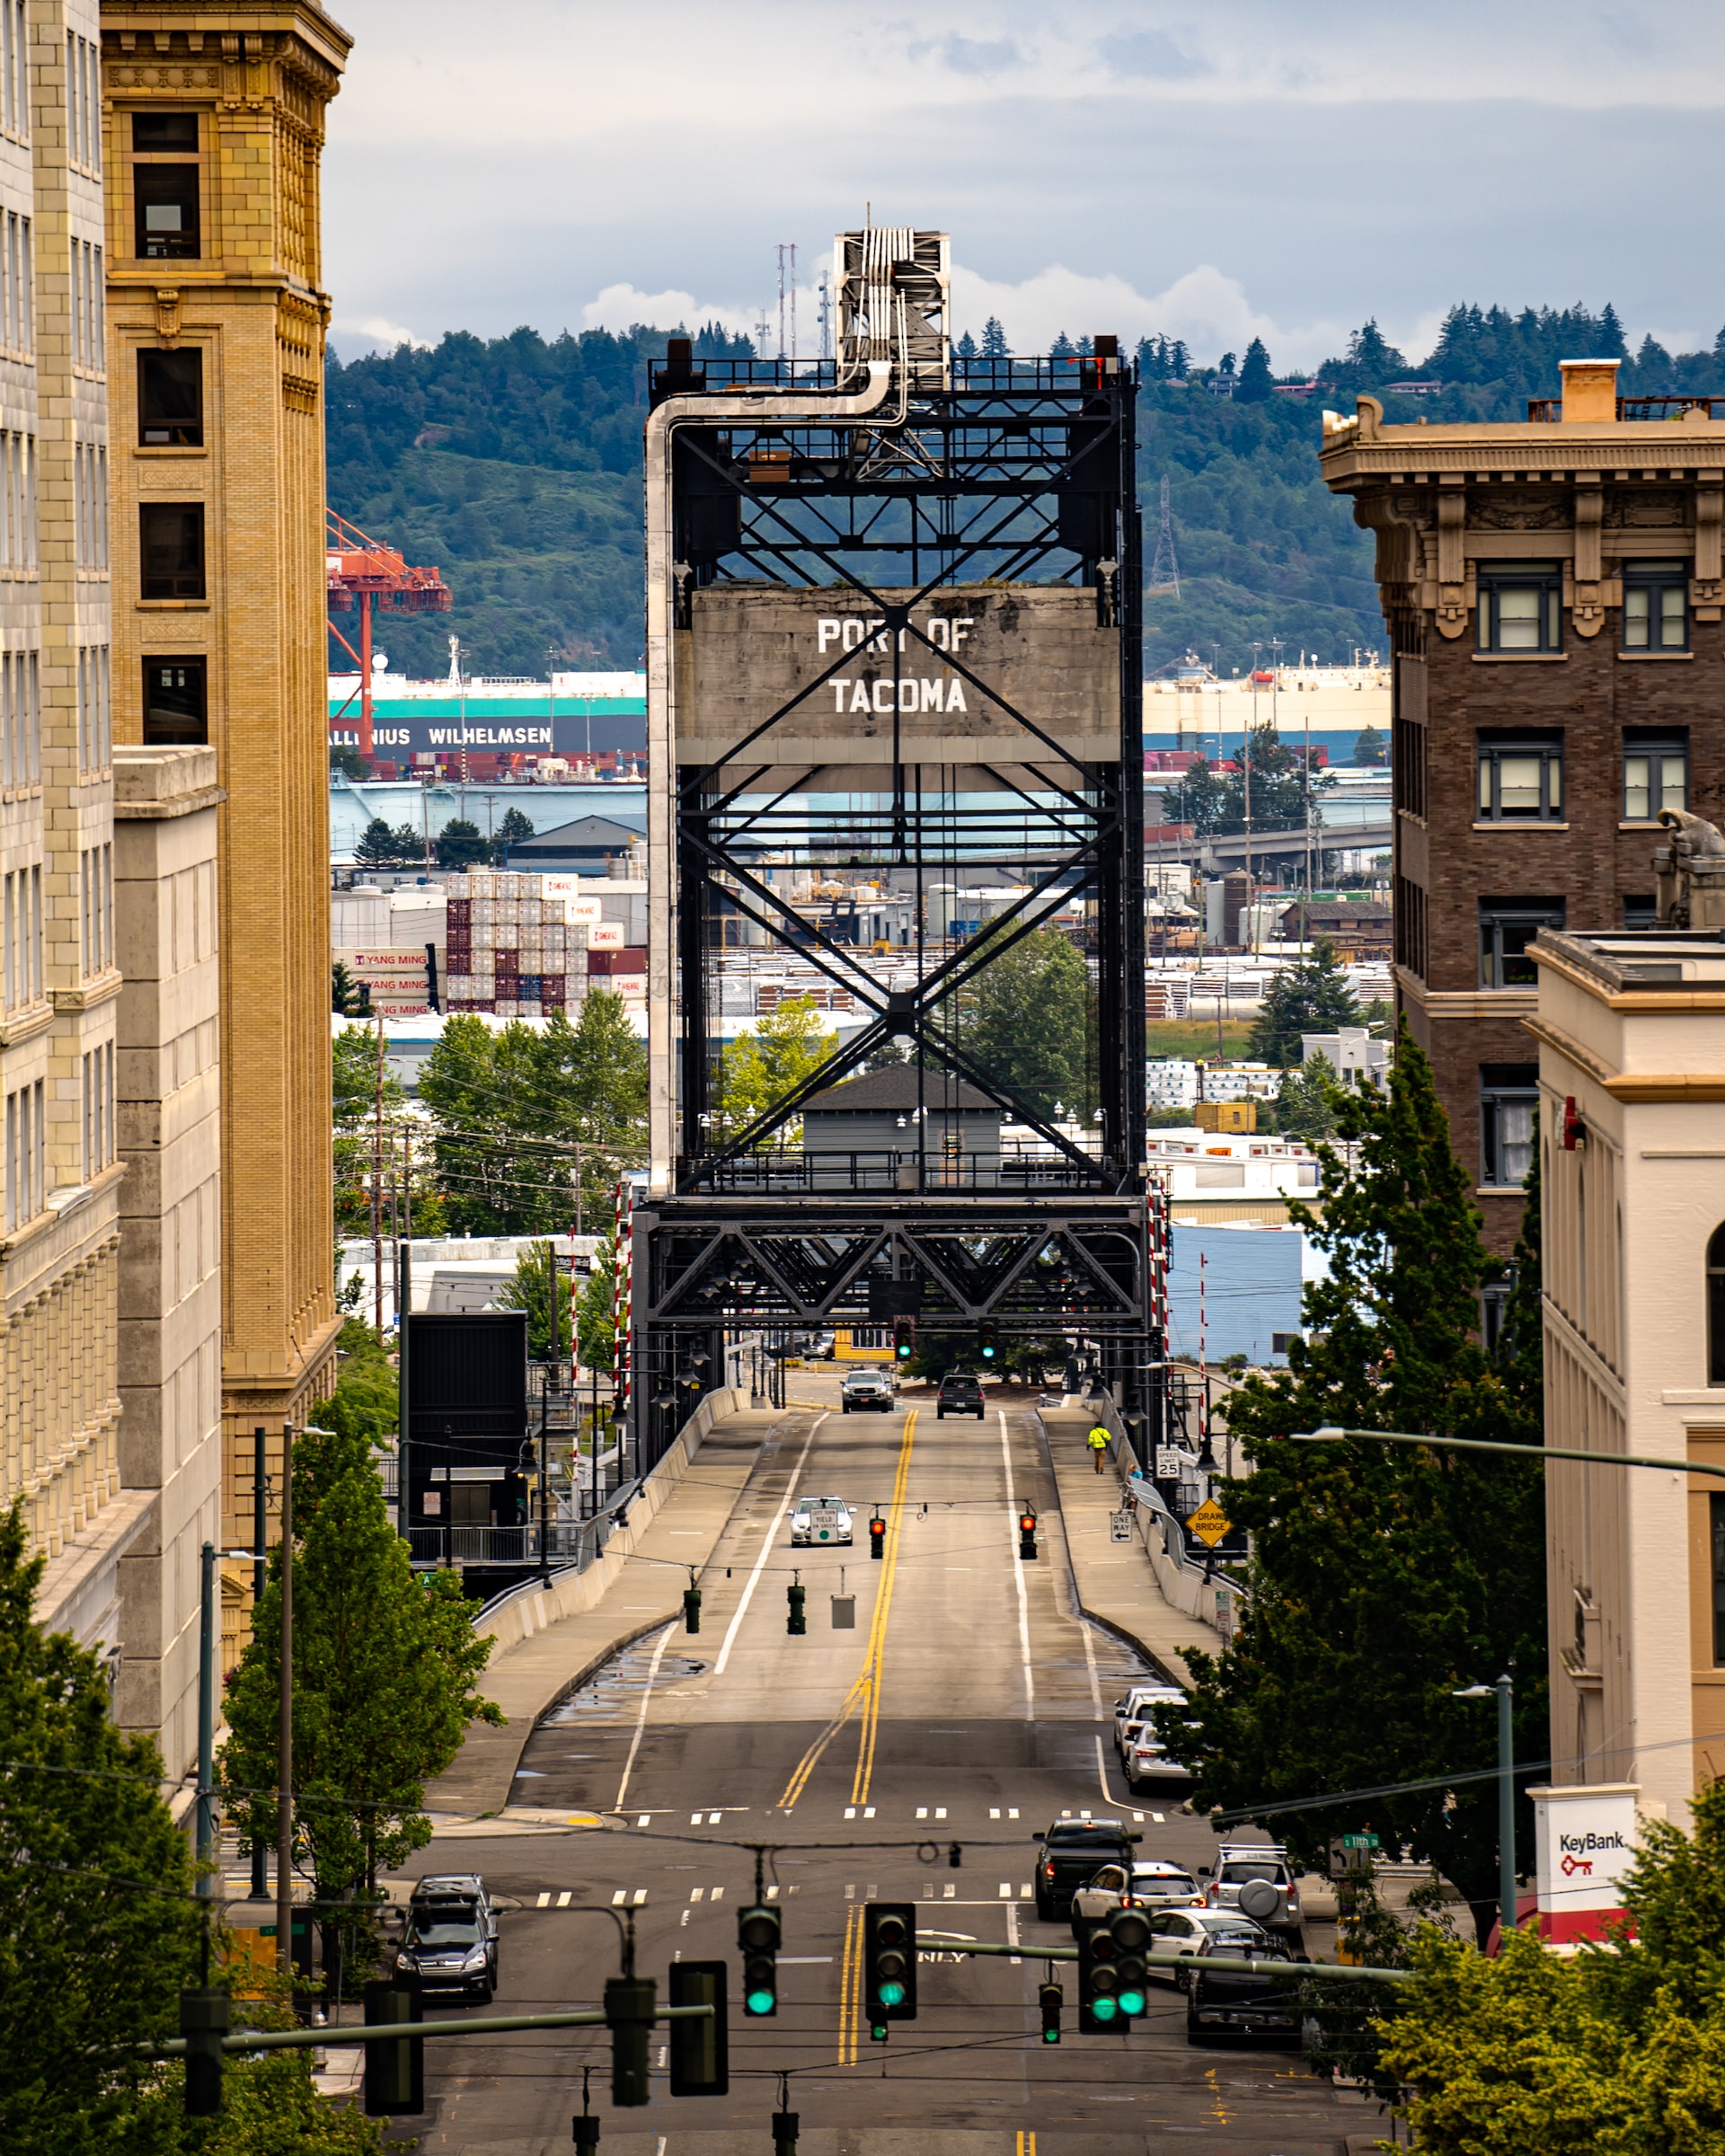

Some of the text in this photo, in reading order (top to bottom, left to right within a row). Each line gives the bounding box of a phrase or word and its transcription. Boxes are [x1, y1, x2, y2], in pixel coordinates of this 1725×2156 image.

[927, 618, 974, 652] OF
[828, 678, 968, 713] TACOMA
[429, 728, 552, 744] WILHELMSEN
[367, 956, 427, 964] YANG MING
[368, 981, 427, 989] YANG MING
[400, 1005, 428, 1013] MING
[1159, 1464, 1177, 1474] 25
[1195, 1523, 1225, 1531] BRIDGE
[1344, 1839, 1350, 1847] S
[1352, 1836, 1369, 1846] 11th
[1560, 1831, 1624, 1854] KeyBank
[917, 1951, 968, 1963] NLY
